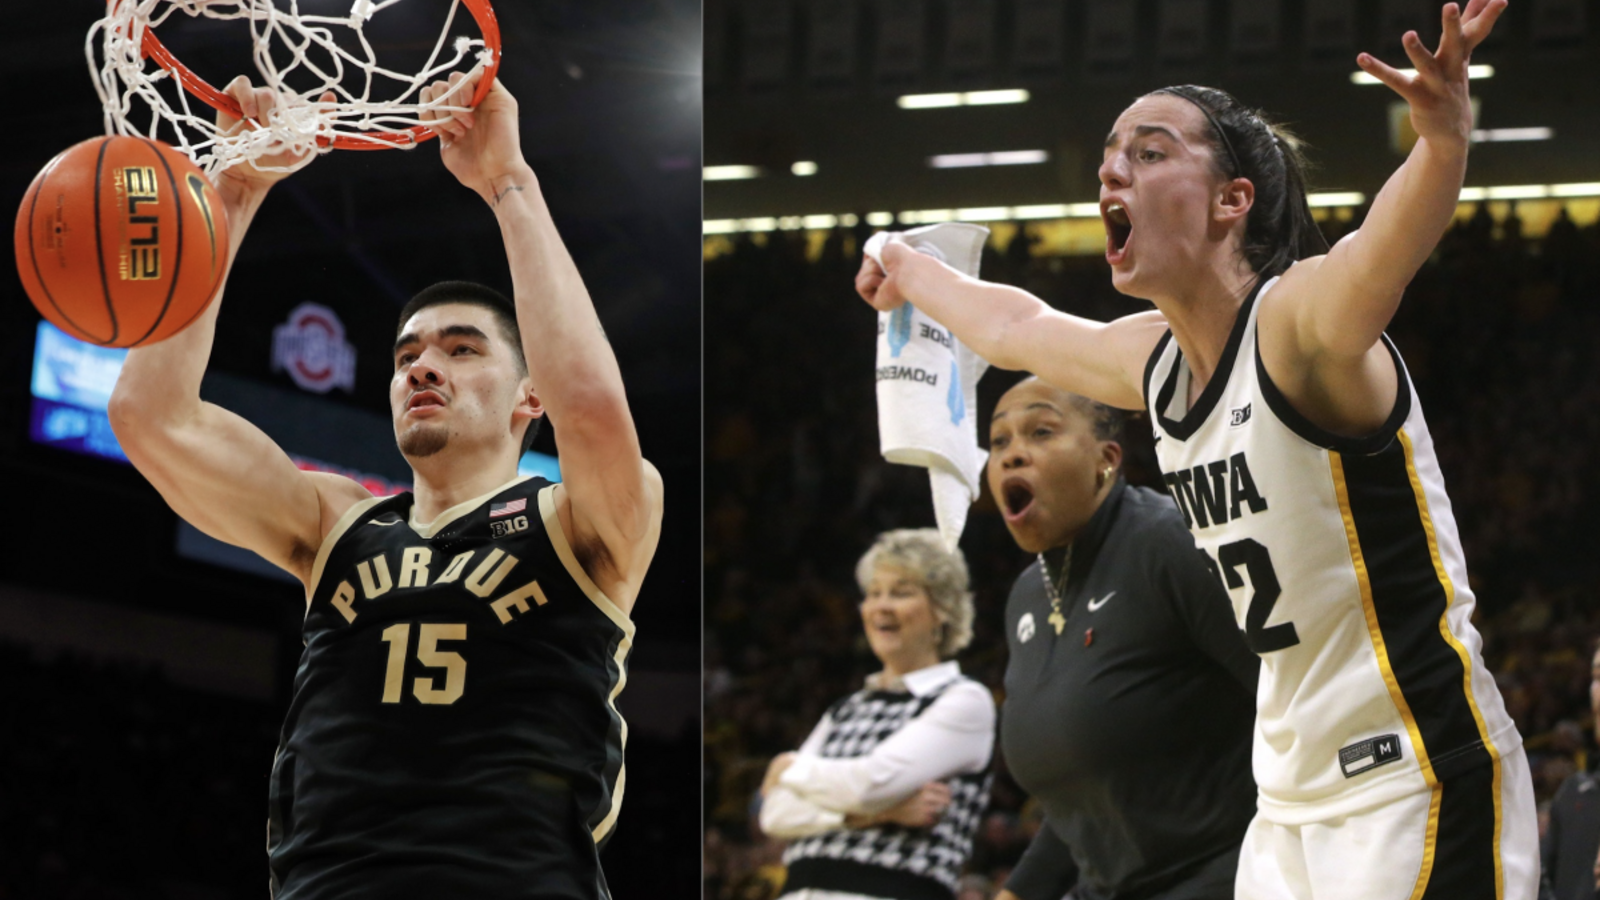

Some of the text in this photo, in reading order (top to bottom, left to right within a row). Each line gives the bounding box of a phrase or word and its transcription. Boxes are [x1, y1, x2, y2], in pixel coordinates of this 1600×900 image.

[123, 167, 161, 280] ELITE
[1162, 451, 1268, 529] OWA
[330, 547, 548, 624] PURDUE
[1196, 538, 1300, 653] 2
[381, 623, 467, 705] 15
[1379, 741, 1391, 755] M
